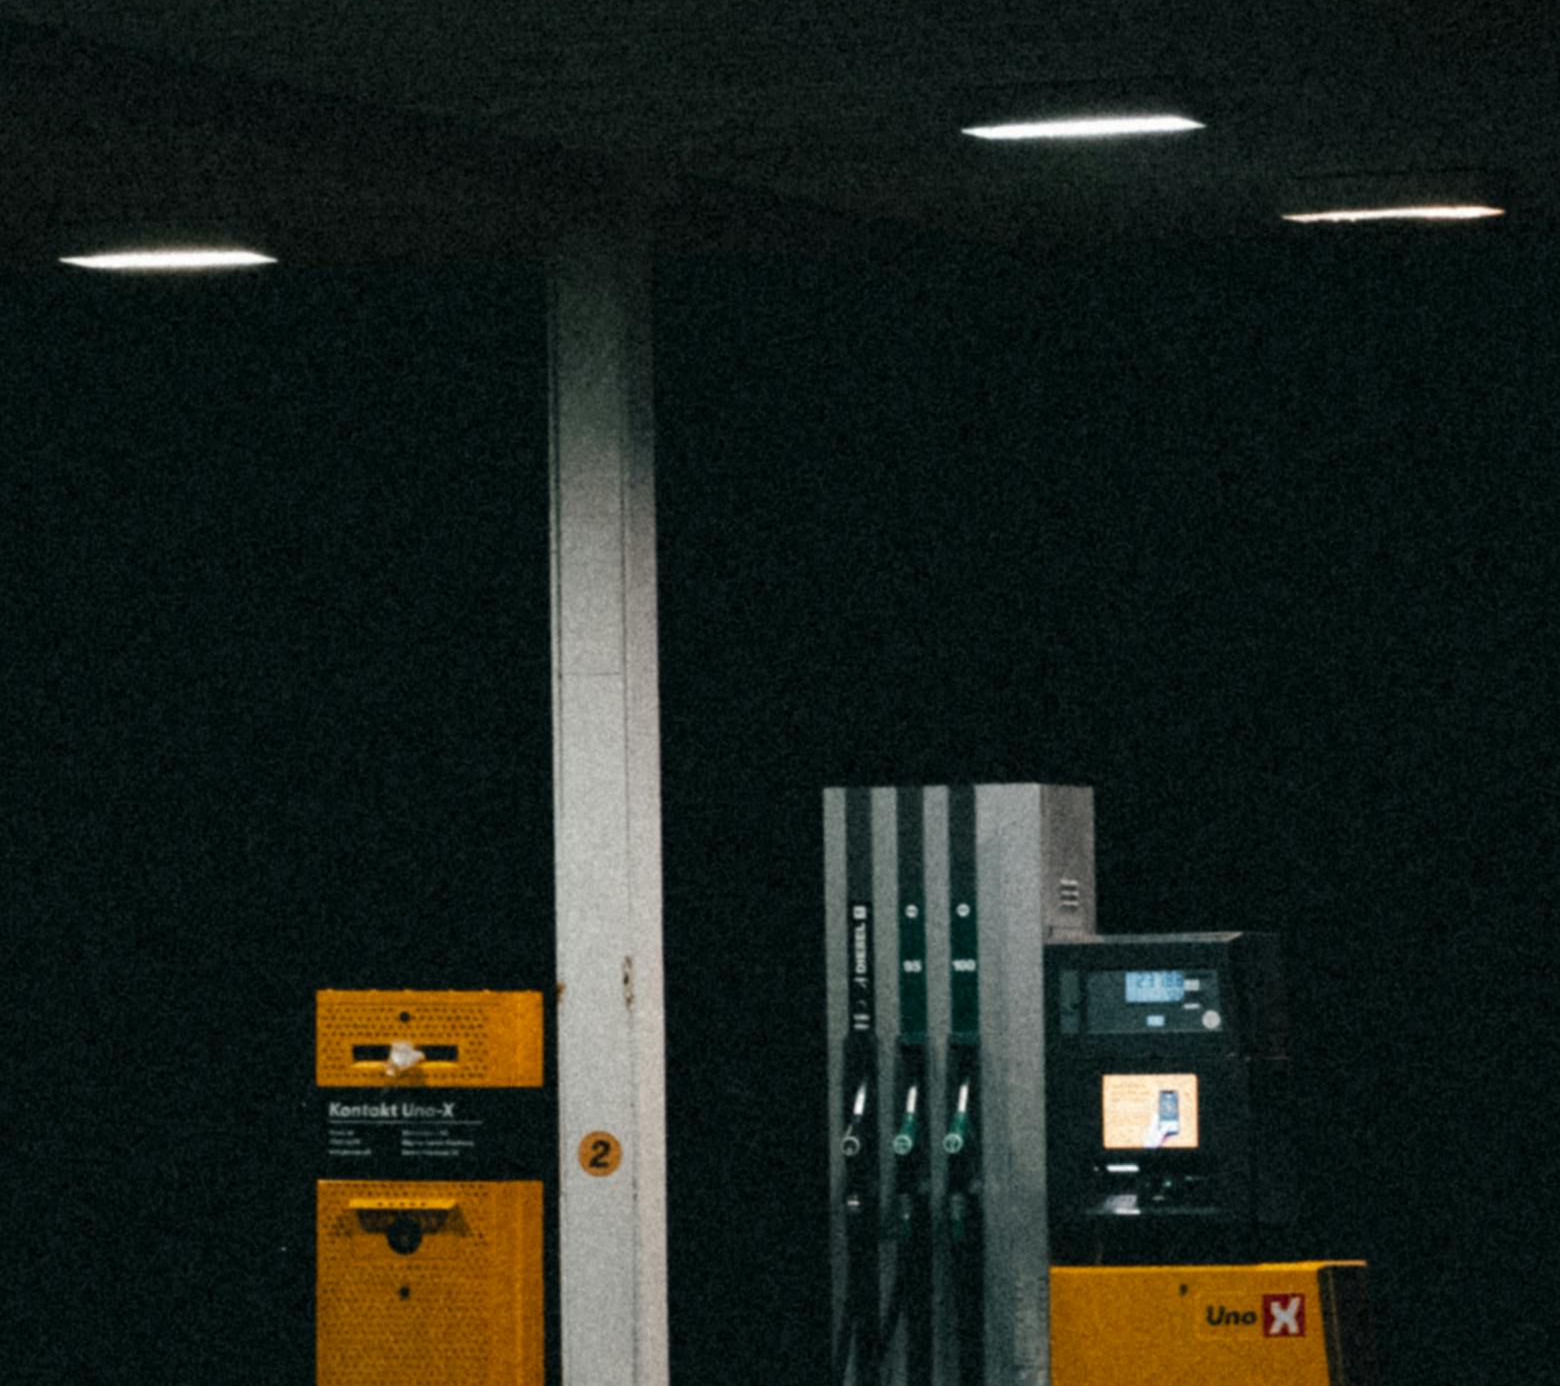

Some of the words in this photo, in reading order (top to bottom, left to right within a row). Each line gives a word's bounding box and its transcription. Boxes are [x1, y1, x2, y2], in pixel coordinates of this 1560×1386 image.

[329, 1101, 398, 1118] Kontakt
[401, 1101, 455, 1118] Uno-X
[589, 1139, 611, 1169] 2
[1206, 1304, 1257, 1326] Uno
[1268, 1295, 1302, 1336] X
